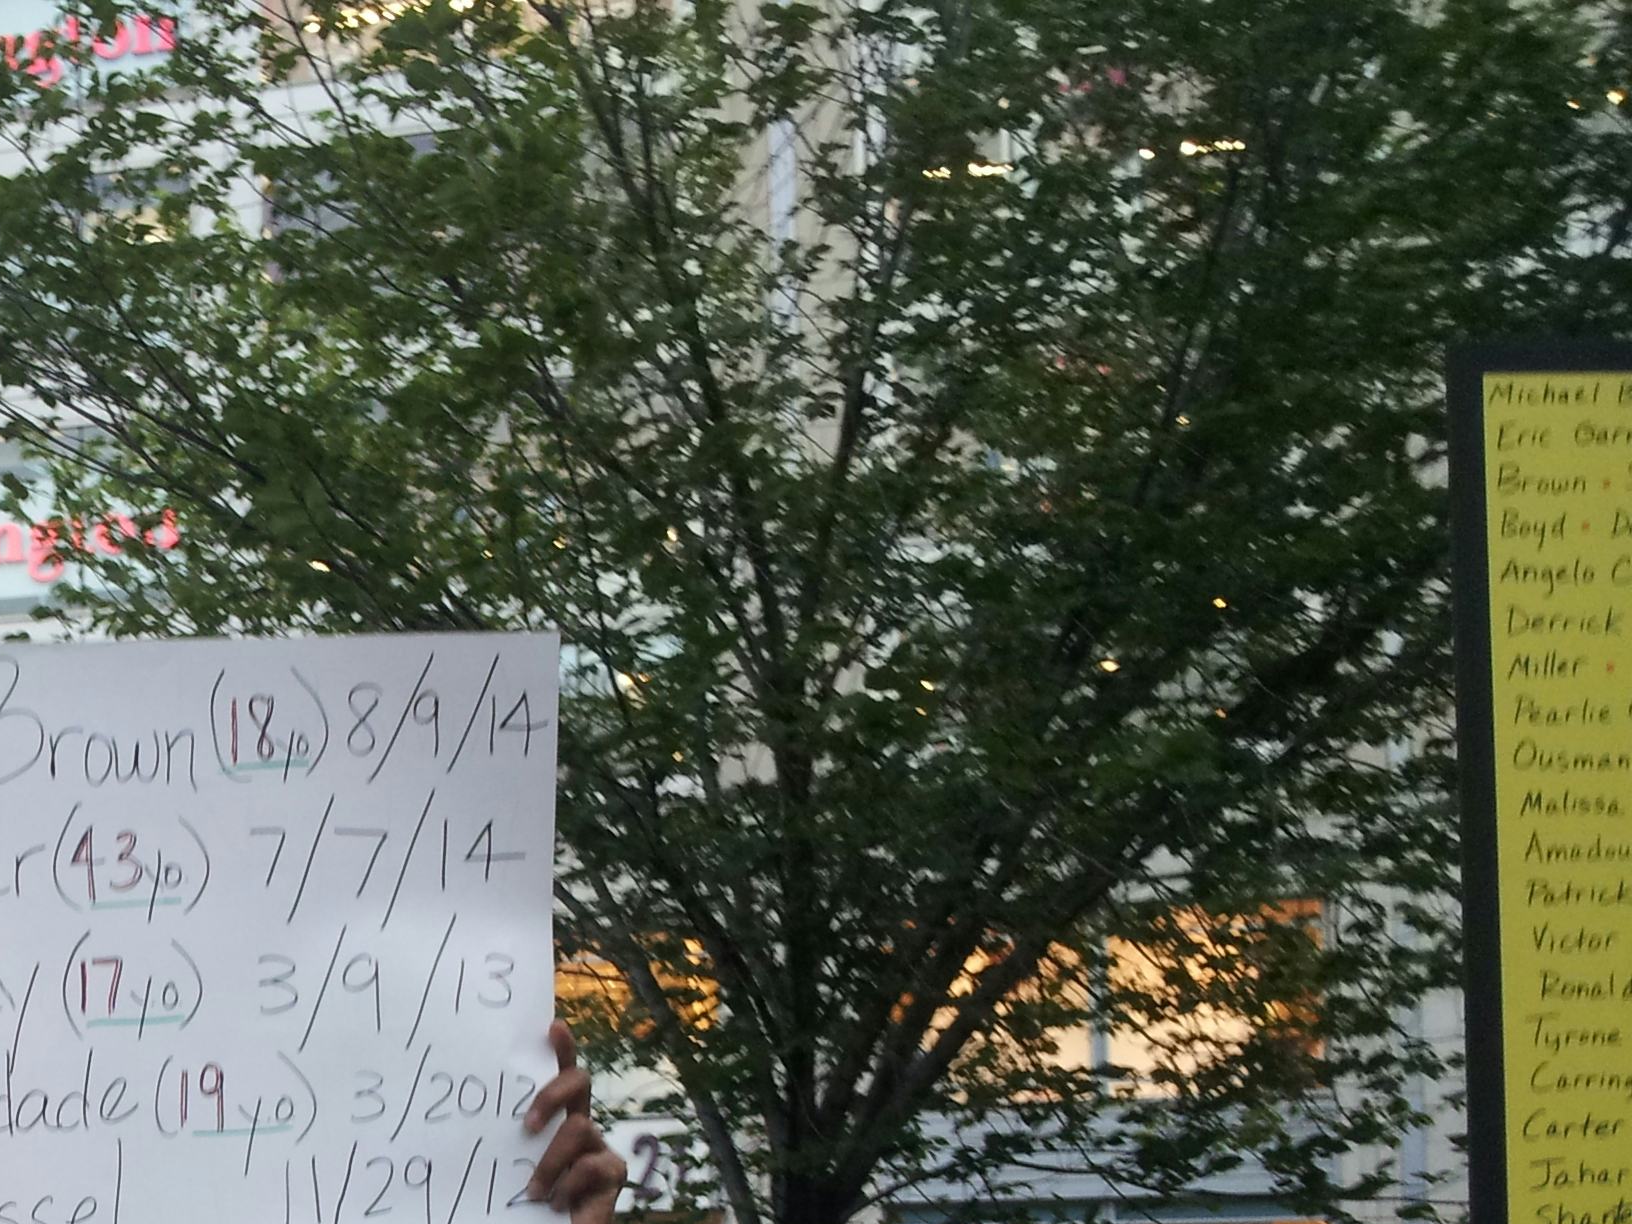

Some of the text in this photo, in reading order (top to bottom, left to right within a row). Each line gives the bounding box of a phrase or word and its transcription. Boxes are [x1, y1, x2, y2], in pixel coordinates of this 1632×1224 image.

[1488, 381, 1600, 405] Michael
[1497, 419, 1553, 451] Eric
[1497, 460, 1586, 495] Brown
[1501, 506, 1566, 551] Boyd
[1500, 558, 1595, 599] Angelo
[1507, 604, 1624, 637] Derrick
[1507, 649, 1588, 680] Miller
[346, 650, 549, 786] 8/9/14
[1514, 693, 1611, 726] Pearlie
[249, 788, 526, 930] 7/7/14
[1524, 830, 1631, 864] Amadou
[1533, 921, 1619, 954] Victor
[257, 913, 515, 1052] 3/9/13
[1525, 1010, 1623, 1056] Tyrone
[351, 1044, 538, 1143] 3/2012
[1523, 1108, 1625, 1142] Carter
